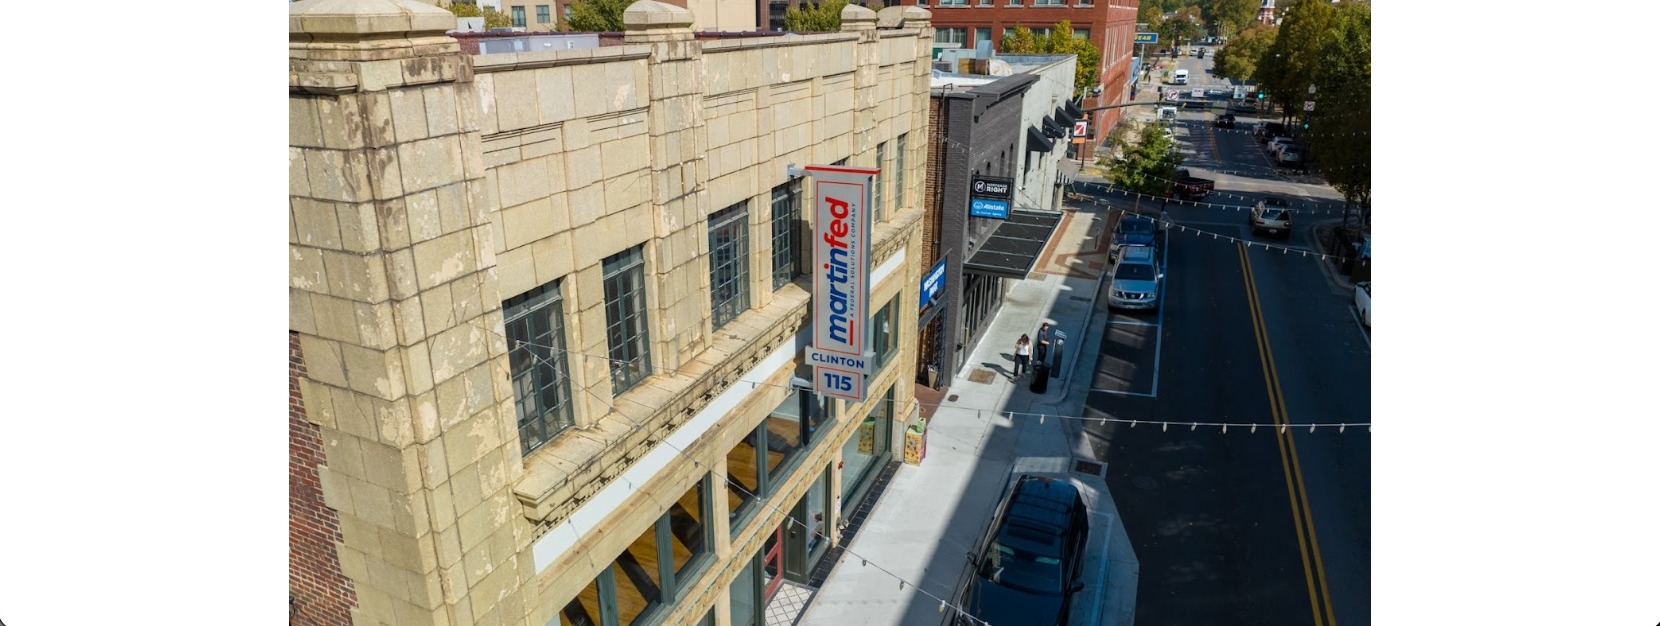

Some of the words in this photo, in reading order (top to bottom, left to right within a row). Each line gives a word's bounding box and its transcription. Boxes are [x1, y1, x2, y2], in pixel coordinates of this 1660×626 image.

[987, 186, 1008, 194] RIGHT
[983, 203, 1005, 211] Allstate
[811, 352, 865, 369] CLINTON
[824, 372, 852, 392] 115
